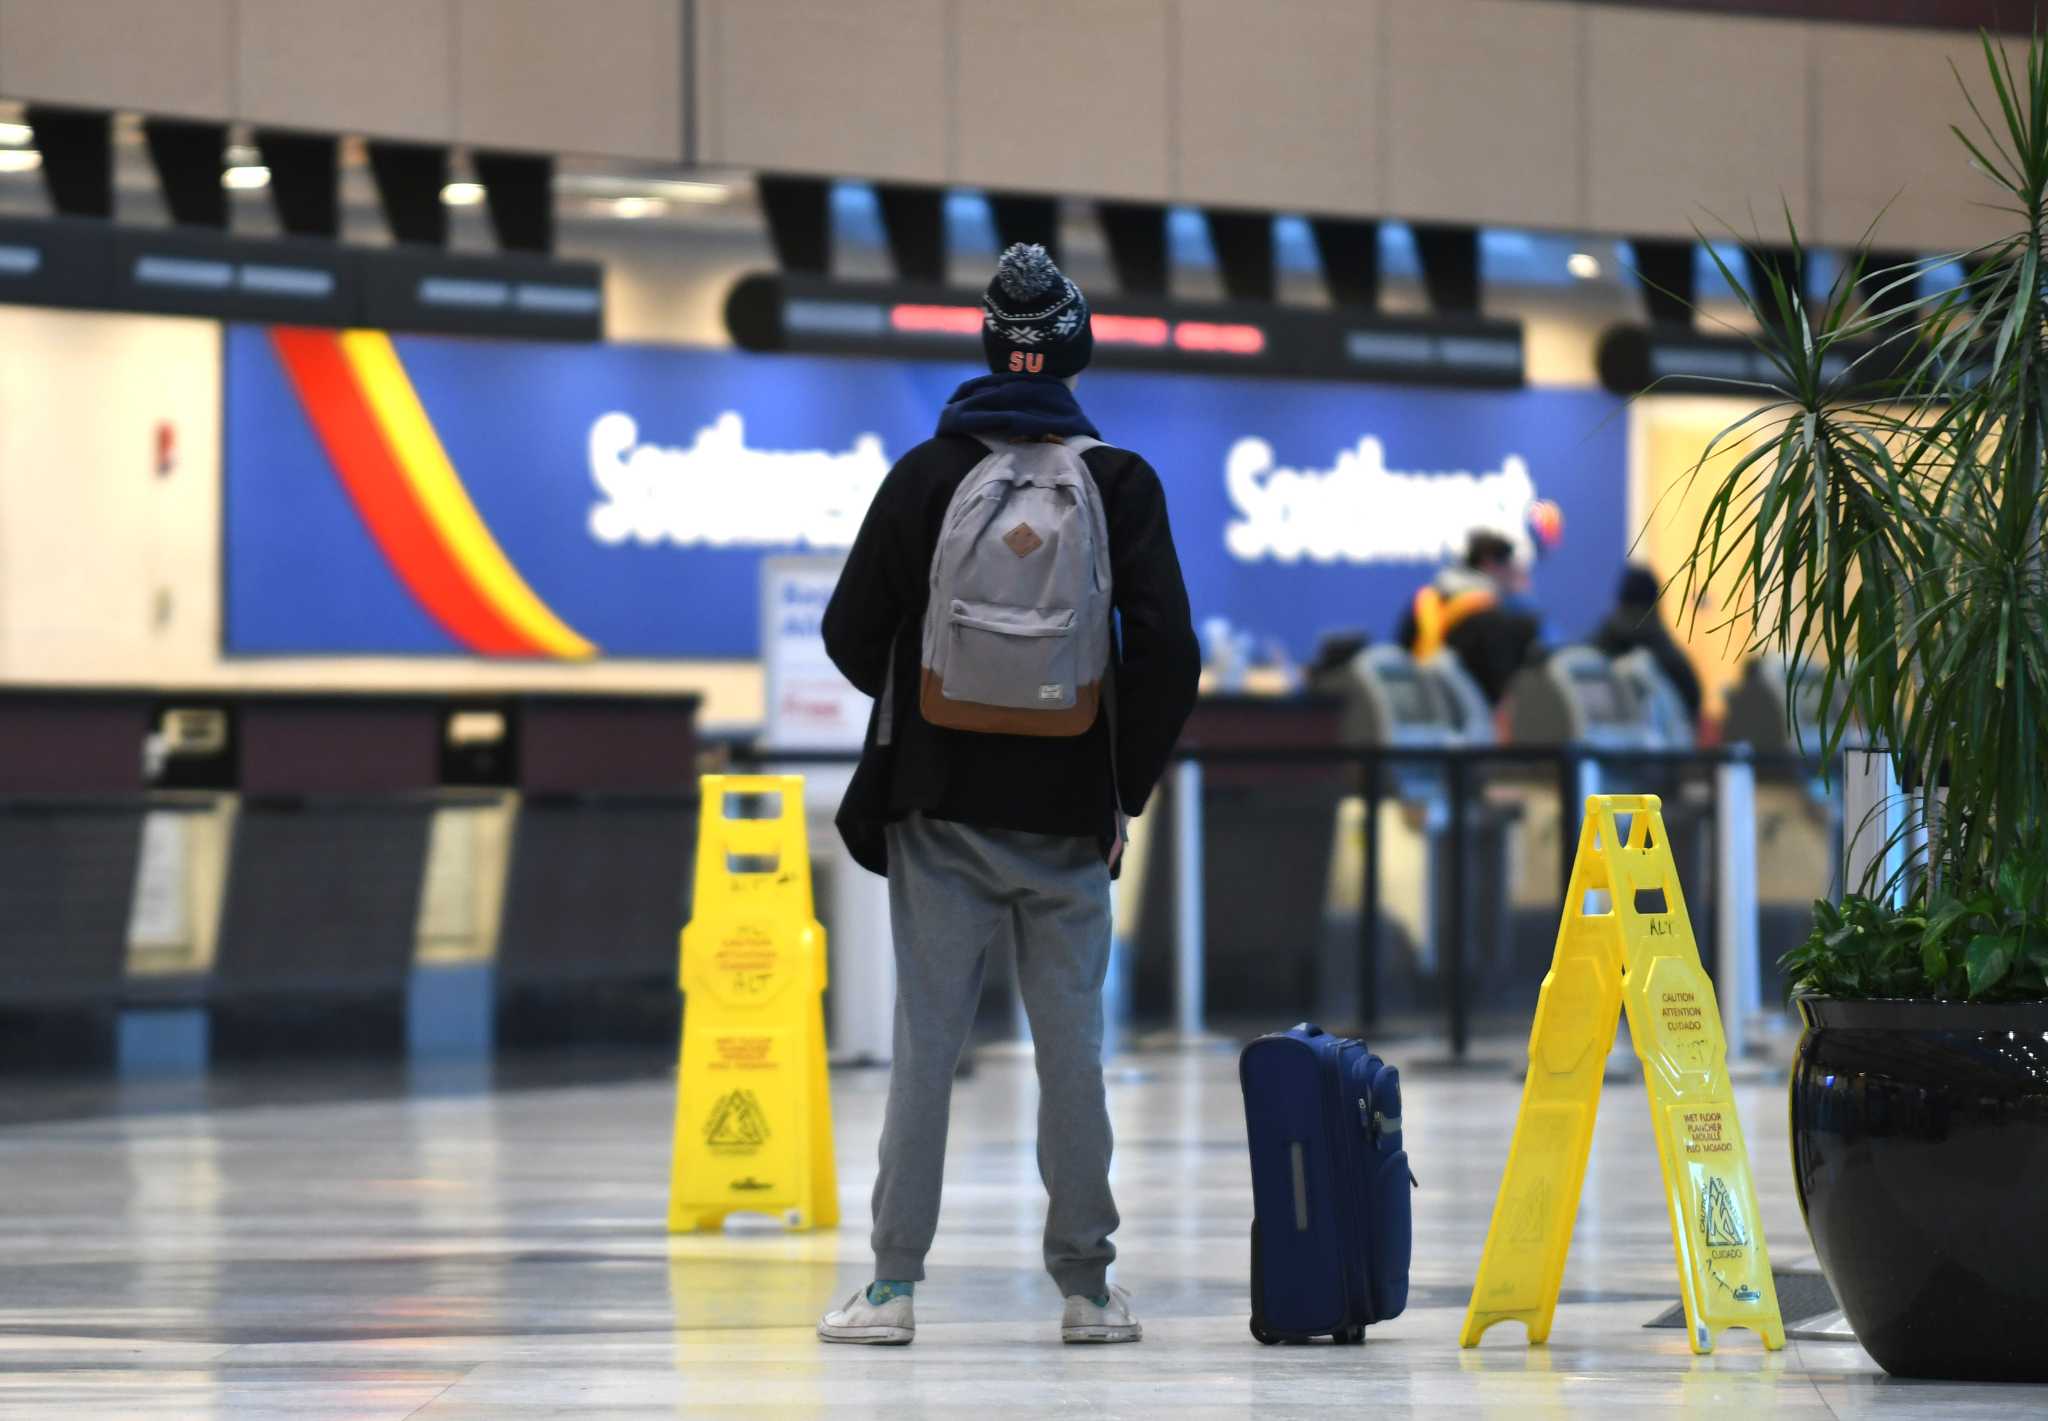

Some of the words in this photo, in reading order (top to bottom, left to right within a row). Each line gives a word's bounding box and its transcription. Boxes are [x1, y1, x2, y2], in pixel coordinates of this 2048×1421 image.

[1008, 350, 1044, 373] SU
[1662, 992, 1695, 1002] CAUTION
[1662, 1008, 1702, 1017] ATTENTION
[1667, 1021, 1702, 1031] CUIDADO
[1684, 1113, 1698, 1122] WET
[1699, 1112, 1721, 1122] FLOOR
